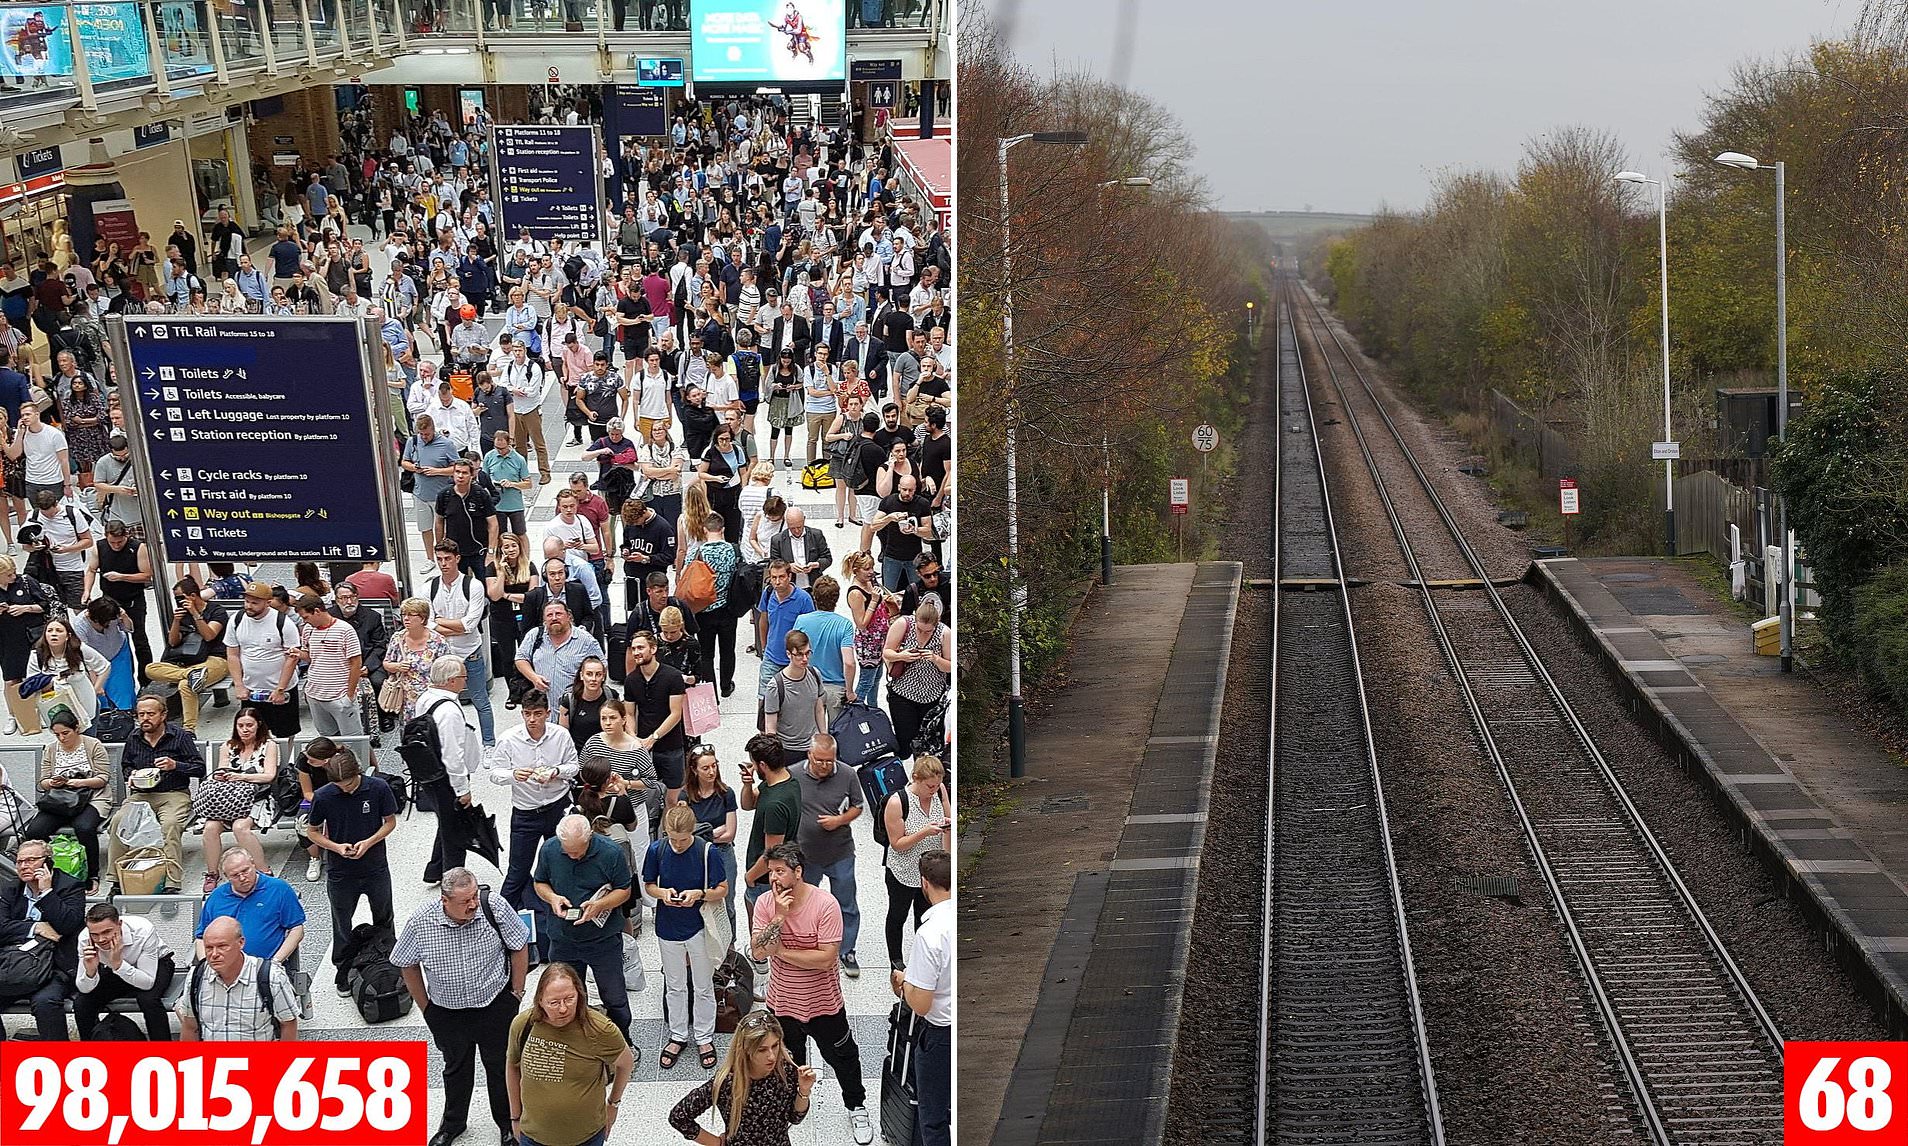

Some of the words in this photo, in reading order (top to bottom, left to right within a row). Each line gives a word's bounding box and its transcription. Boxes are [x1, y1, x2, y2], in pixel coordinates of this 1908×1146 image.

[32, 149, 53, 164] Tickets
[172, 326, 193, 337] TfL
[195, 326, 217, 337] Rail
[179, 368, 219, 379] Toilets
[182, 389, 222, 399] Toilets
[258, 393, 285, 401] babycare
[187, 409, 212, 419] Left
[213, 409, 264, 422] Luggage
[191, 429, 233, 440] Station
[236, 430, 292, 442] reception
[1198, 426, 1213, 437] 60
[1198, 440, 1212, 450] 75
[198, 469, 230, 482] Cycle
[232, 470, 262, 480] racks
[201, 489, 227, 499] First
[229, 489, 246, 499] aid
[203, 509, 228, 520] Way
[231, 510, 251, 518] out
[206, 528, 247, 538] Tickets
[322, 546, 342, 556] Lift
[630, 538, 653, 554] POLO
